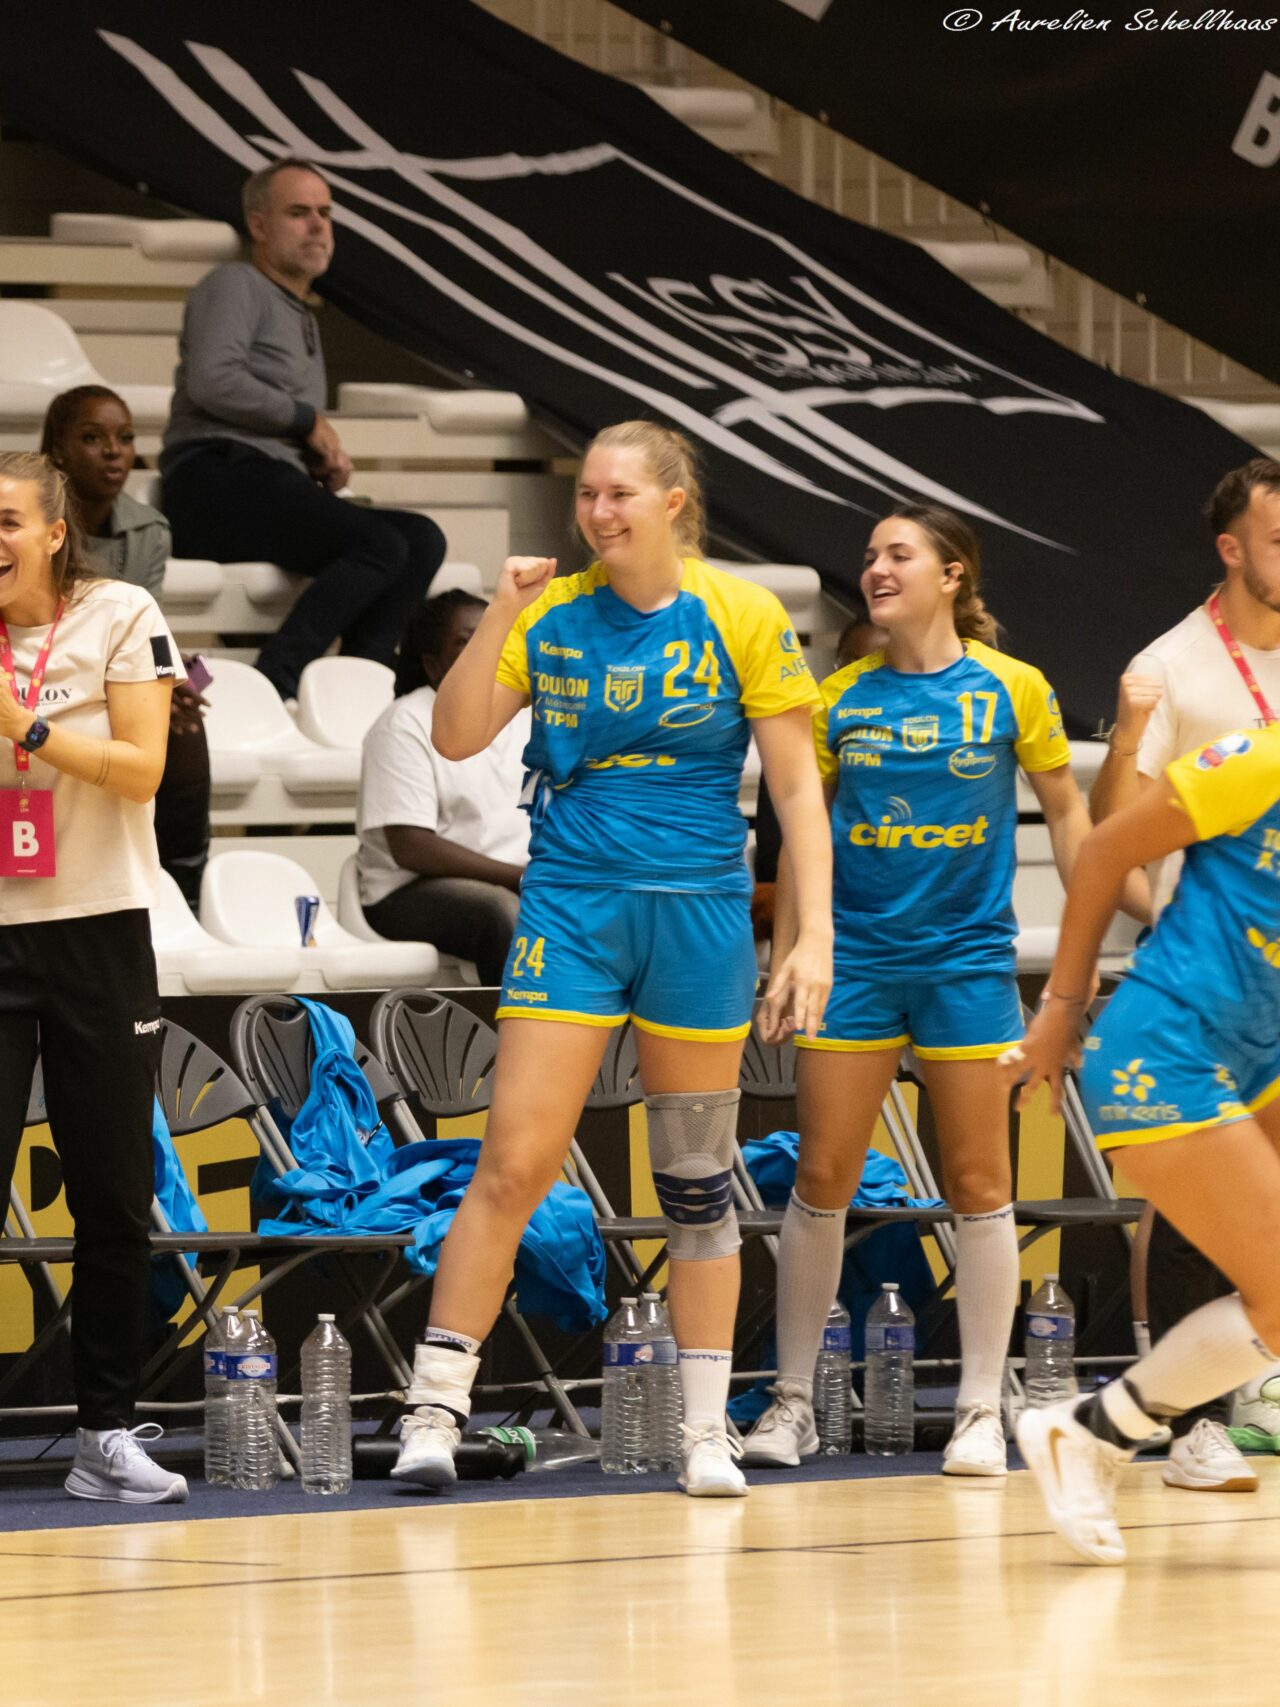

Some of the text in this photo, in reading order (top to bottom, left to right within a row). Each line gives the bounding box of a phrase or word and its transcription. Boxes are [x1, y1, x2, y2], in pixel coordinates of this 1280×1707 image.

[539, 641, 584, 660] Kempa
[662, 640, 721, 697] 24
[956, 691, 998, 743] 17
[847, 752, 881, 767] TPM
[12, 821, 40, 857] B
[849, 815, 989, 849] circet
[512, 937, 545, 977] 24
